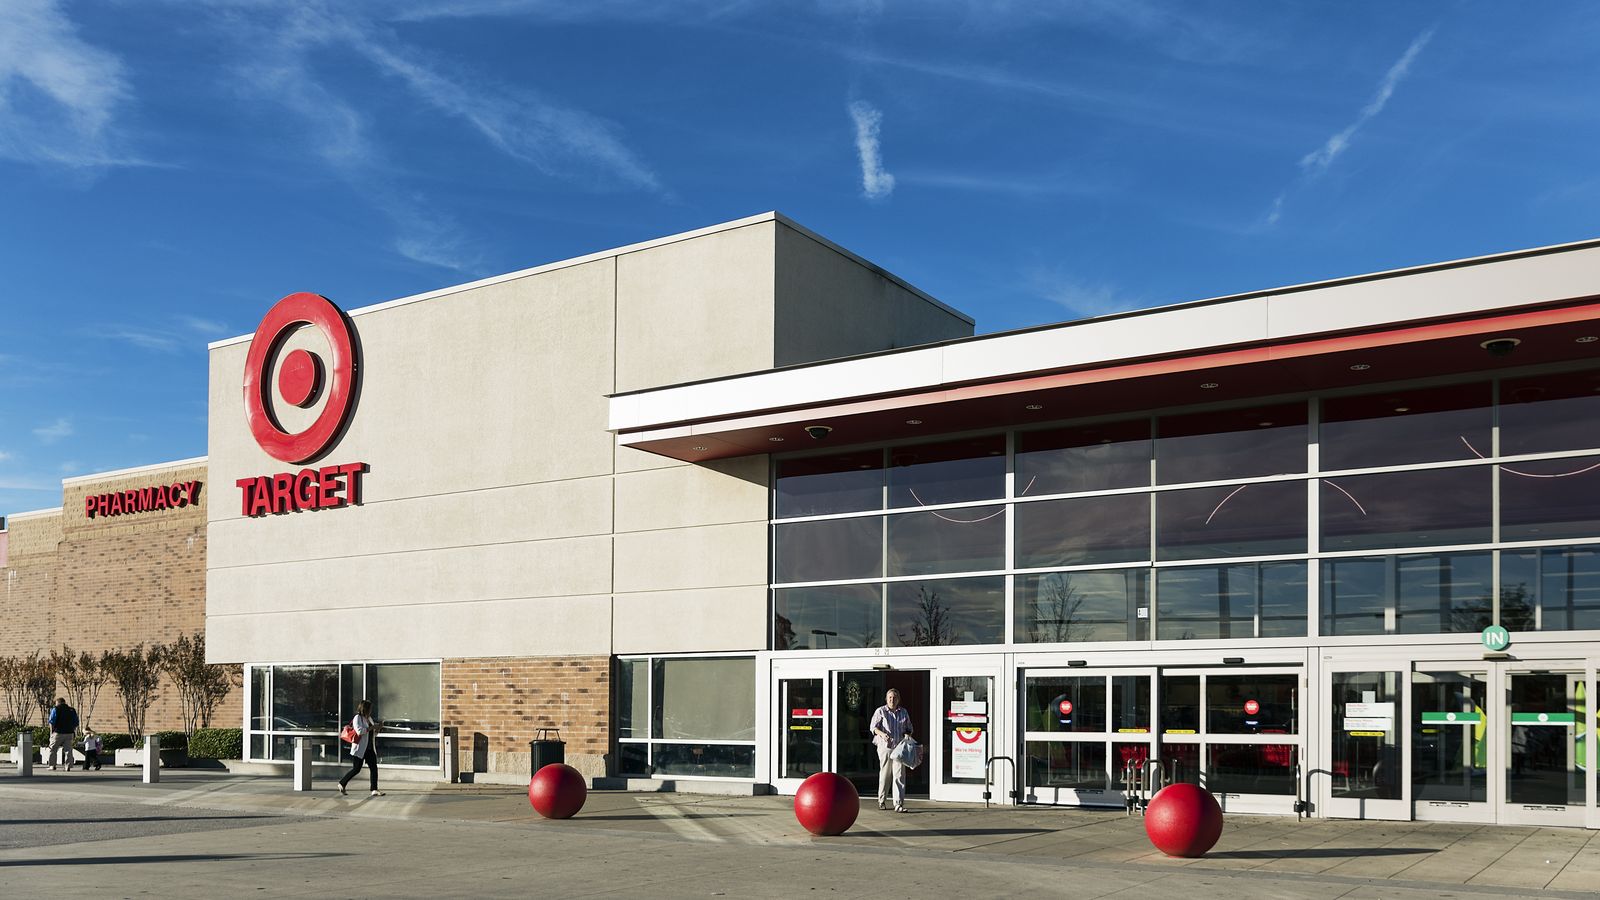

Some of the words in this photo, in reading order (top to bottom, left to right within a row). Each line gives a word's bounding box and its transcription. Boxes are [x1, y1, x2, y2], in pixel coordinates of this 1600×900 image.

[86, 480, 199, 518] PHARMACY
[236, 462, 364, 516] TARGET
[1486, 631, 1504, 645] IN
